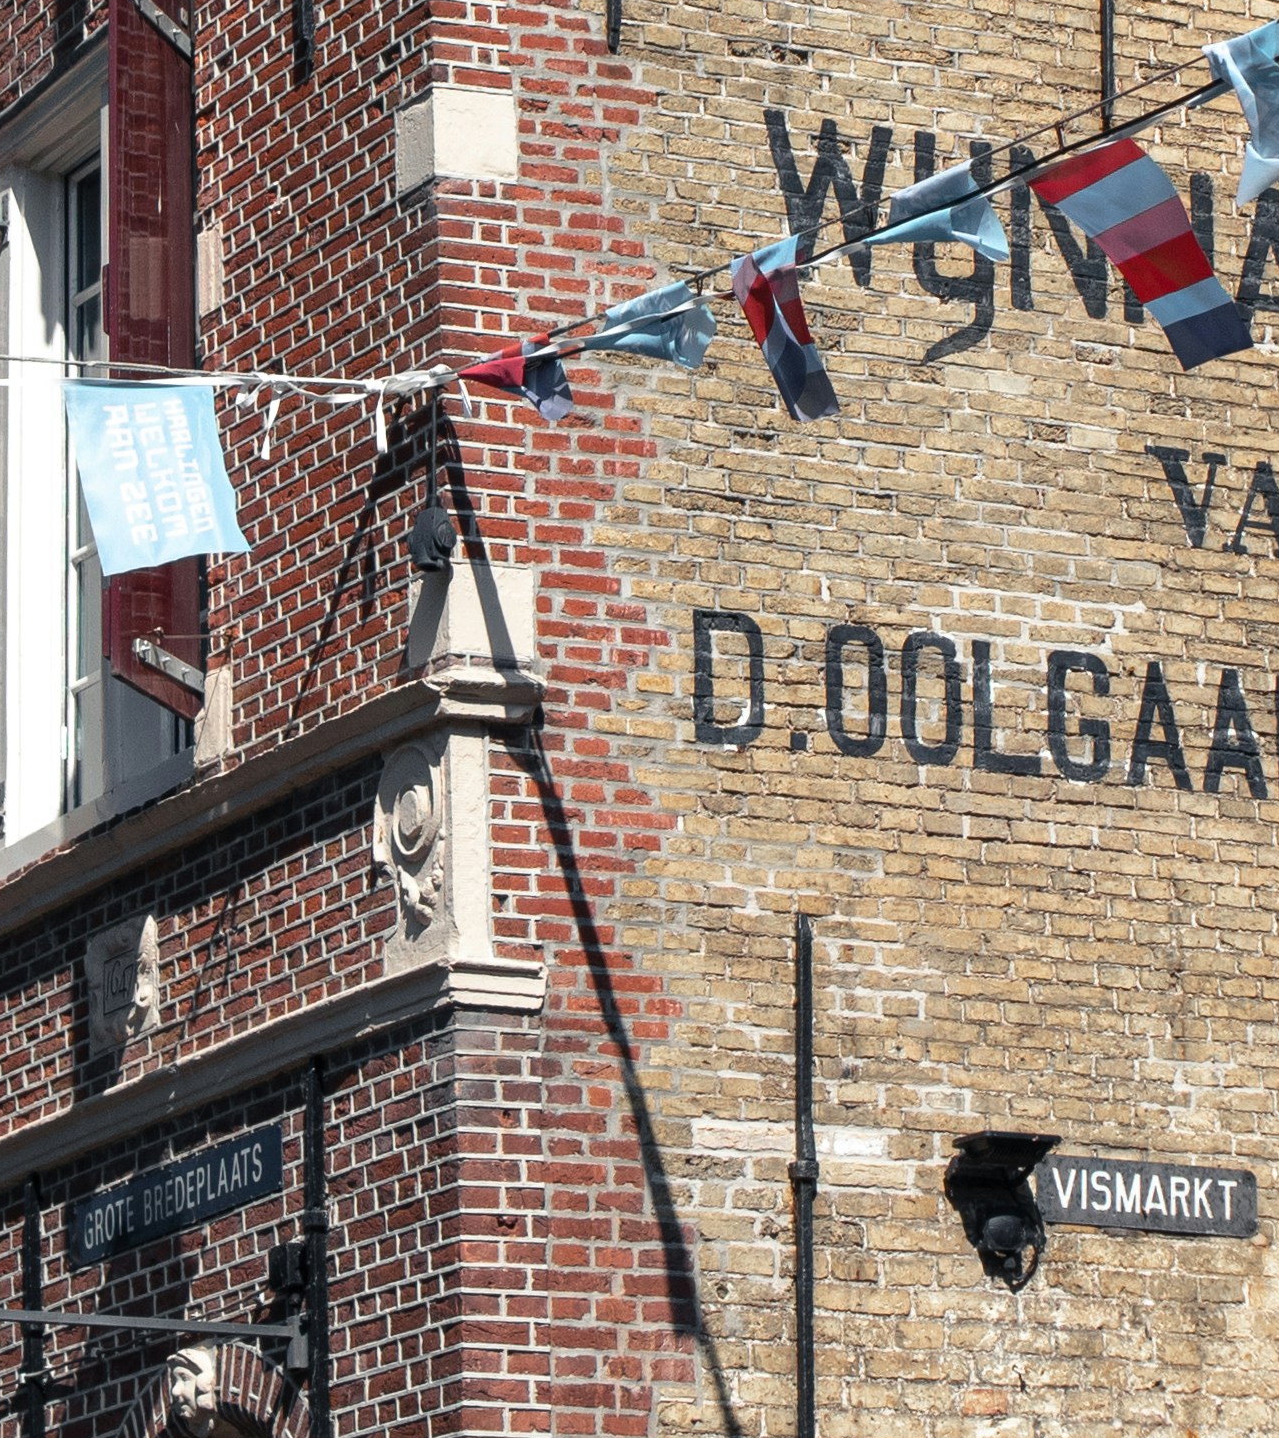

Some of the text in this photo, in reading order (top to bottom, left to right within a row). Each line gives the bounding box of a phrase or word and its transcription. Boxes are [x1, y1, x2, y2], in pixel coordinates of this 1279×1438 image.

[103, 405, 158, 547] AAN ZEE
[133, 402, 190, 539] WELKOM
[162, 399, 215, 535] HARLINGEN
[83, 1142, 263, 1251] GROTE BREDEPLAATS
[1052, 1167, 1239, 1221] VISMARKT
